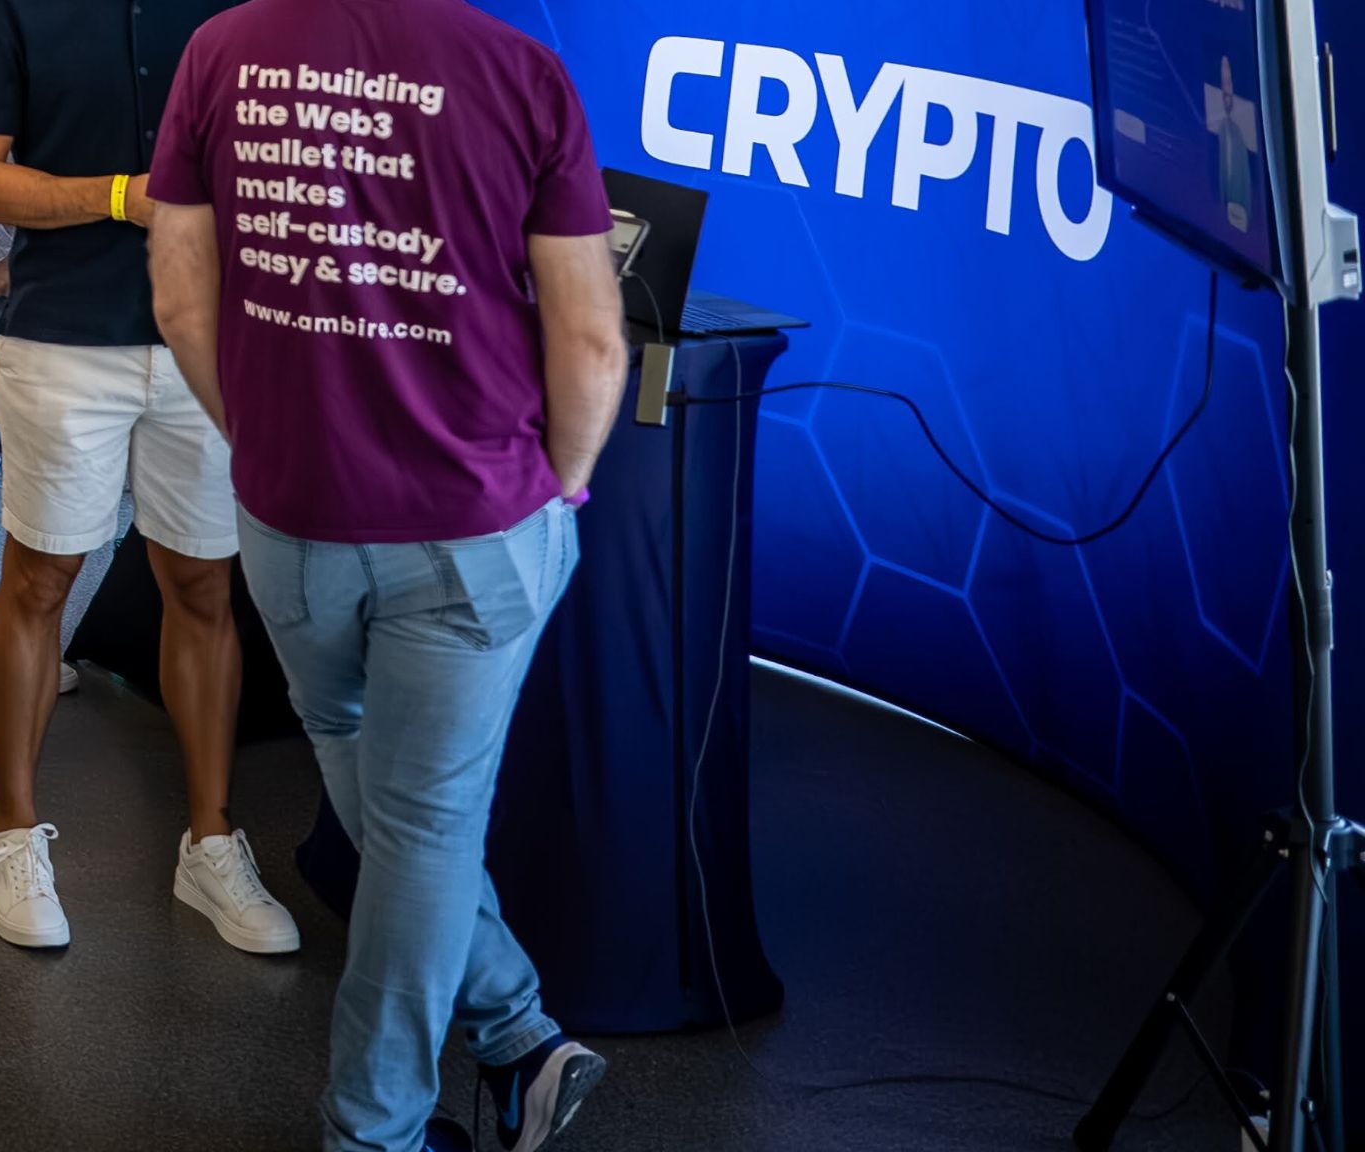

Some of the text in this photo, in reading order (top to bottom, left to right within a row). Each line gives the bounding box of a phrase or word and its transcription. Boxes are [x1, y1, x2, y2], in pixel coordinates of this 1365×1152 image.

[237, 64, 445, 115] I'm building
[235, 99, 395, 140] the Web3
[234, 138, 416, 180] wallet that
[641, 35, 1113, 261] CRYPTO
[236, 176, 347, 208] makes
[236, 211, 445, 265] self-custody
[239, 247, 467, 296] easy & secure.
[243, 298, 453, 346] www.ambire.com
